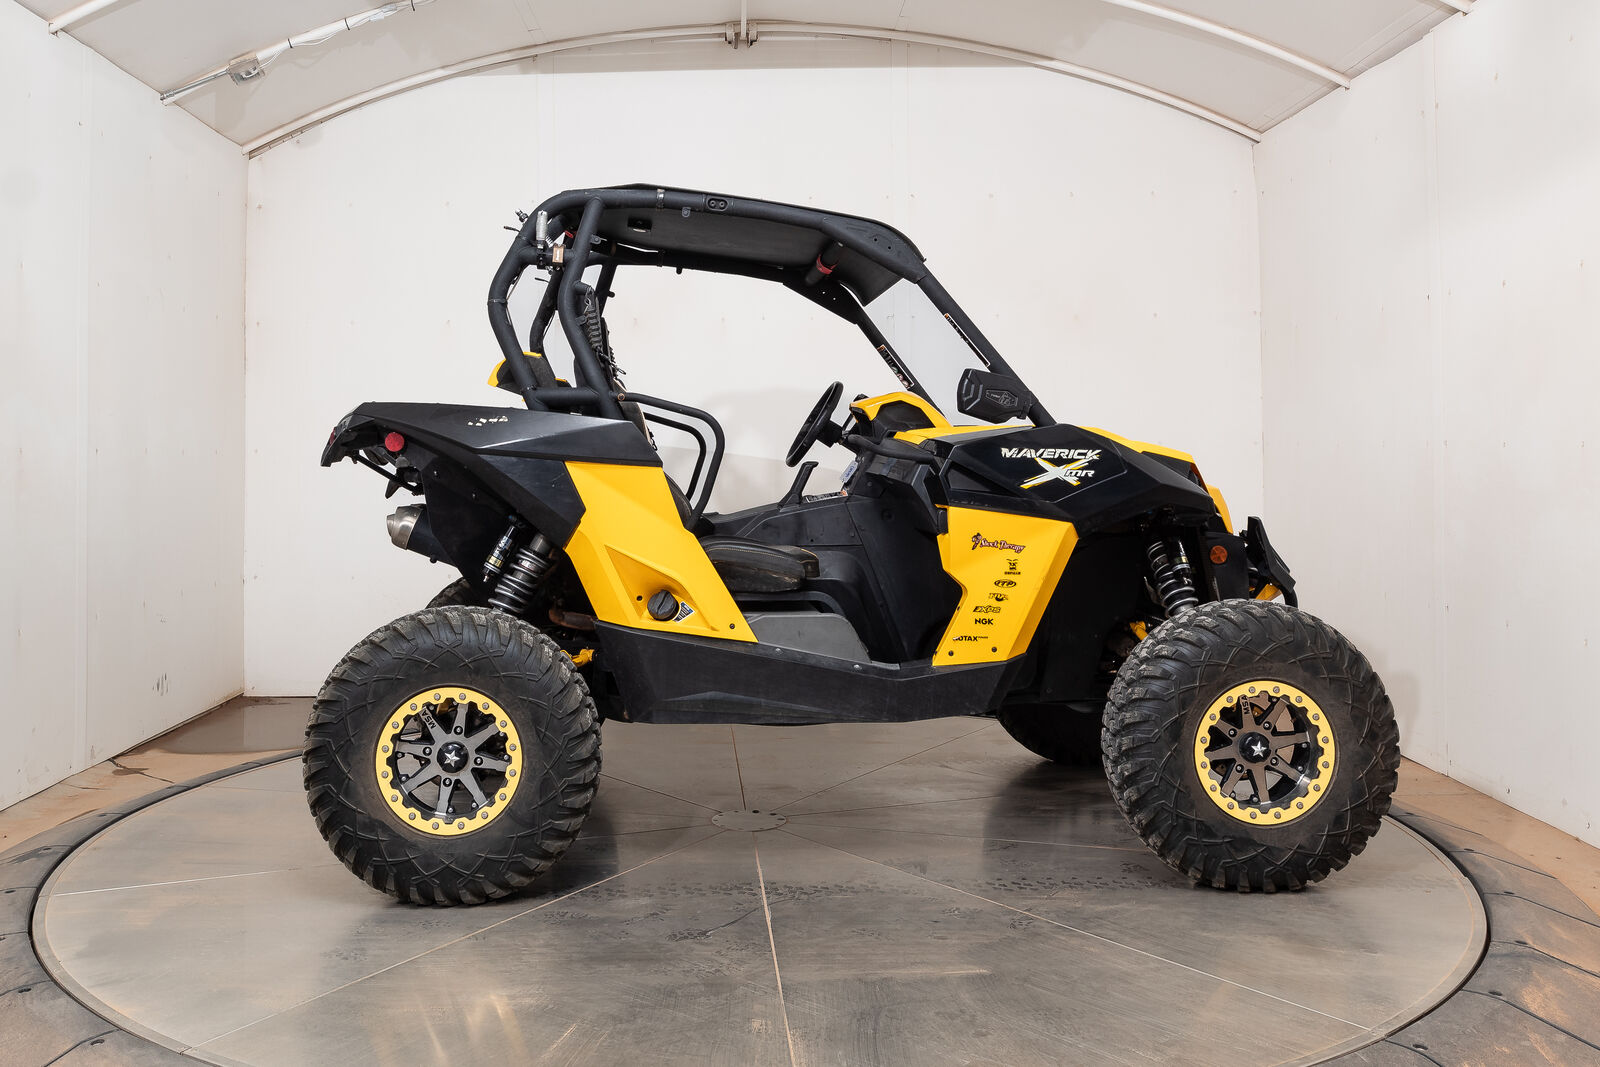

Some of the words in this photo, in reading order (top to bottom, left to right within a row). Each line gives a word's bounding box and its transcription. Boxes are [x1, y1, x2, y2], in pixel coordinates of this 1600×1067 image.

[1000, 447, 1102, 460] MAVERICK
[974, 618, 994, 626] NGK
[1241, 695, 1250, 714] MSA
[421, 711, 436, 729] MSA
